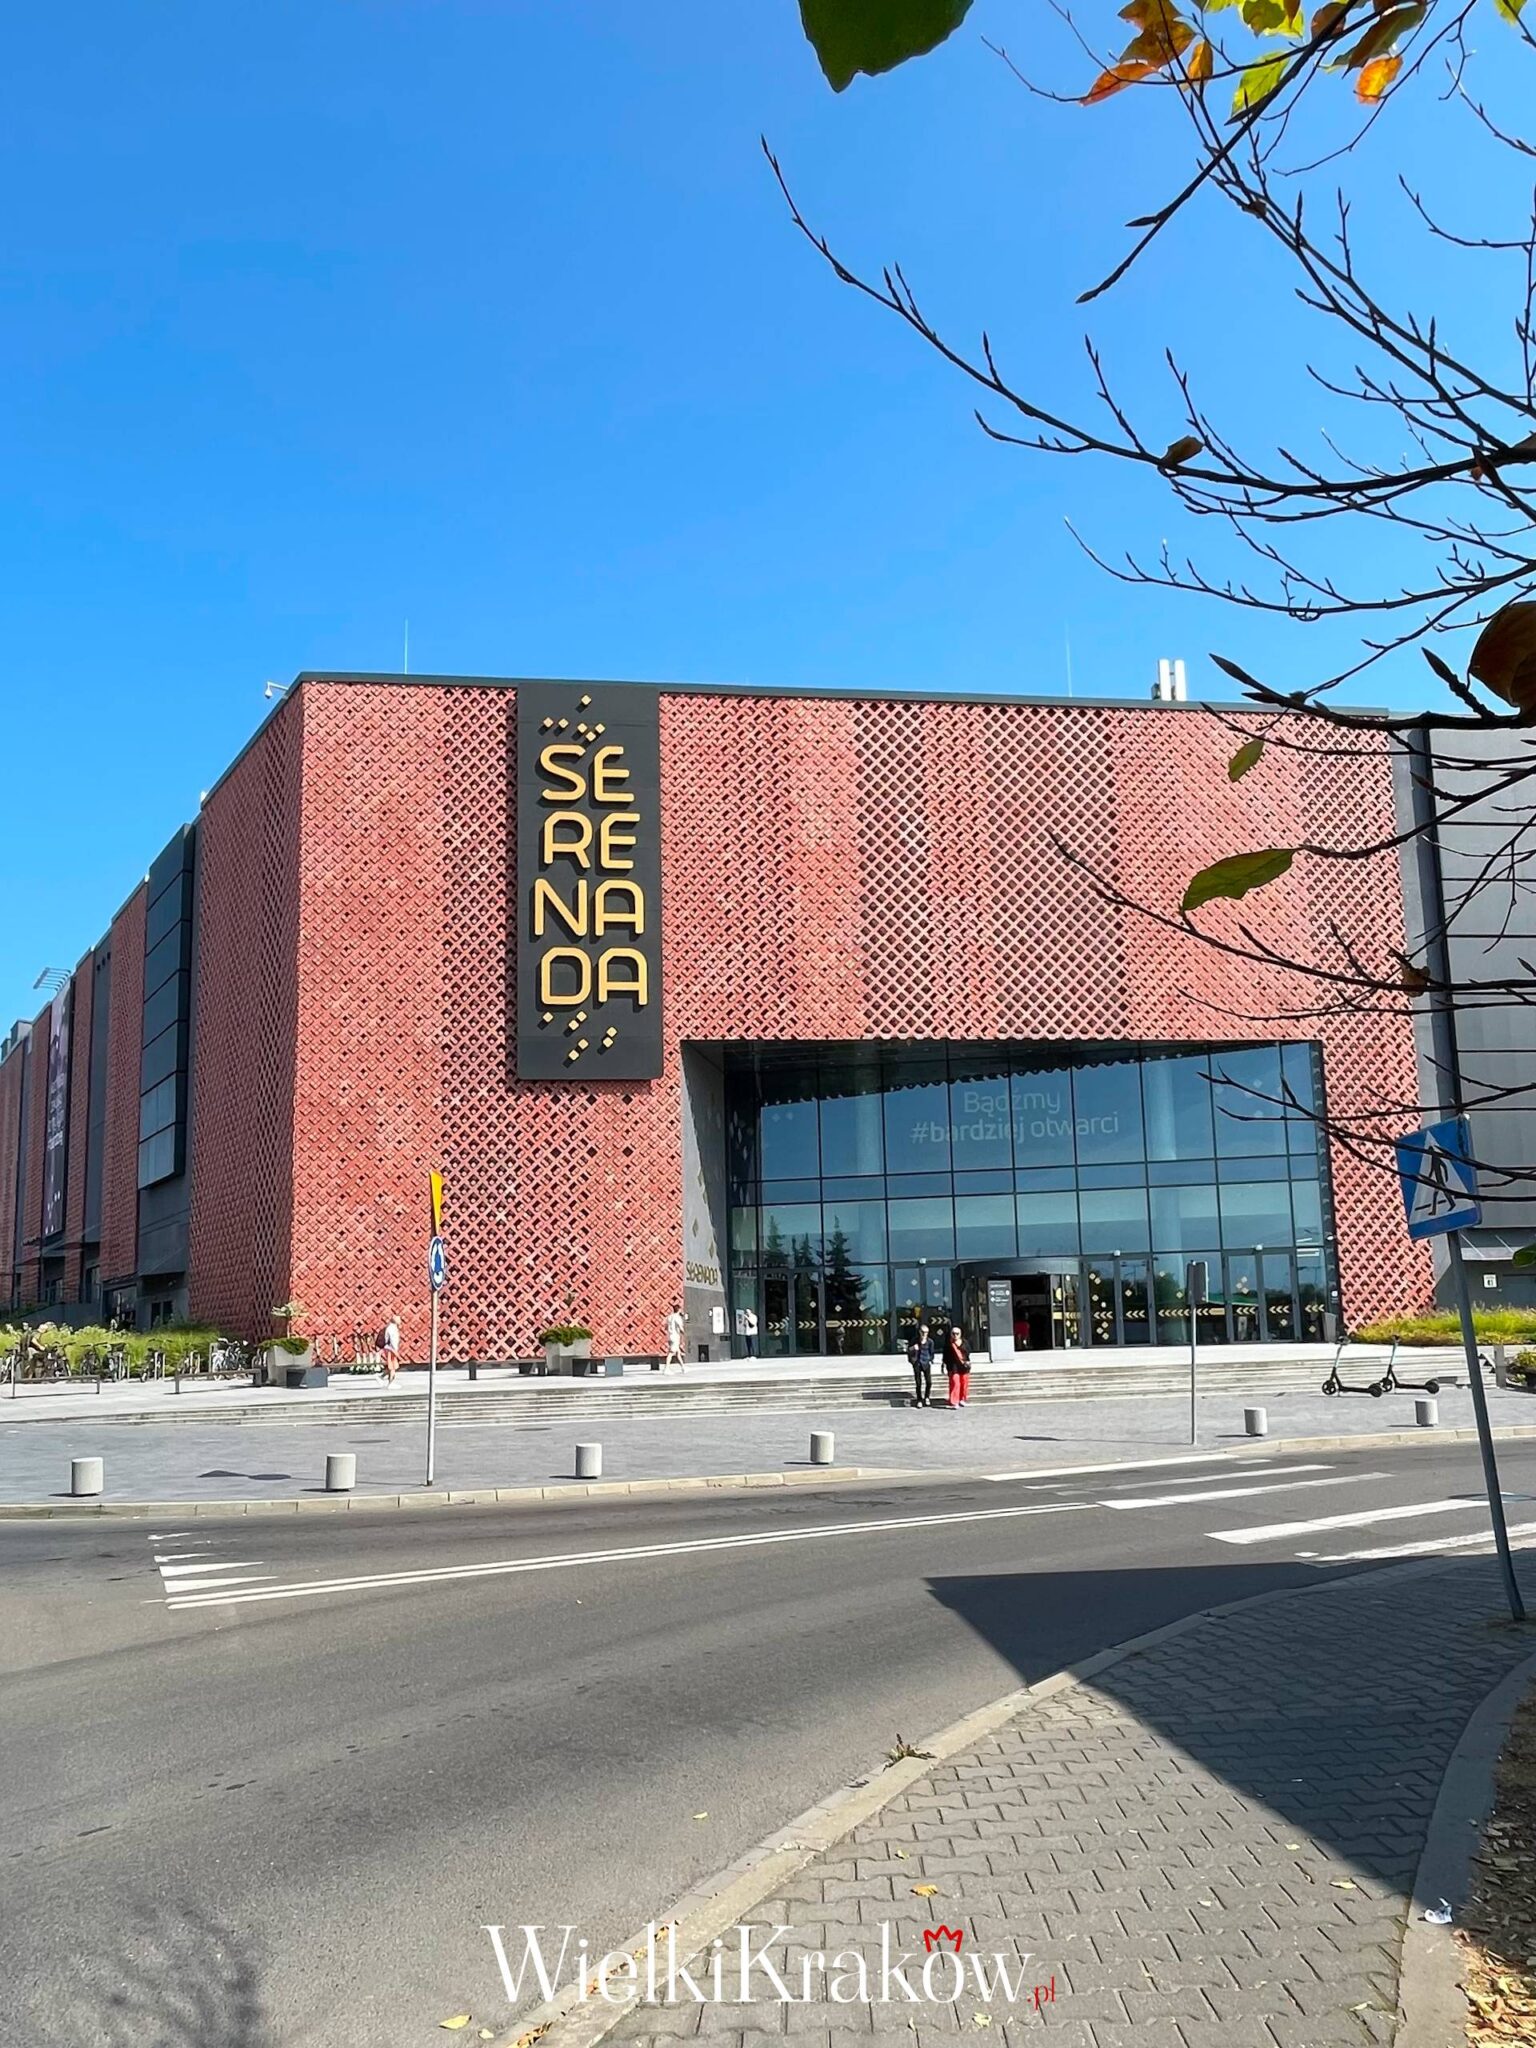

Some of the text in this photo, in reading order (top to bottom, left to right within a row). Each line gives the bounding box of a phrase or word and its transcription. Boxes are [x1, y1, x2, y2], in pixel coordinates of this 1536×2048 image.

[963, 1088, 1061, 1117] Bądźmy
[910, 1110, 1119, 1144] #bardziej otwarci
